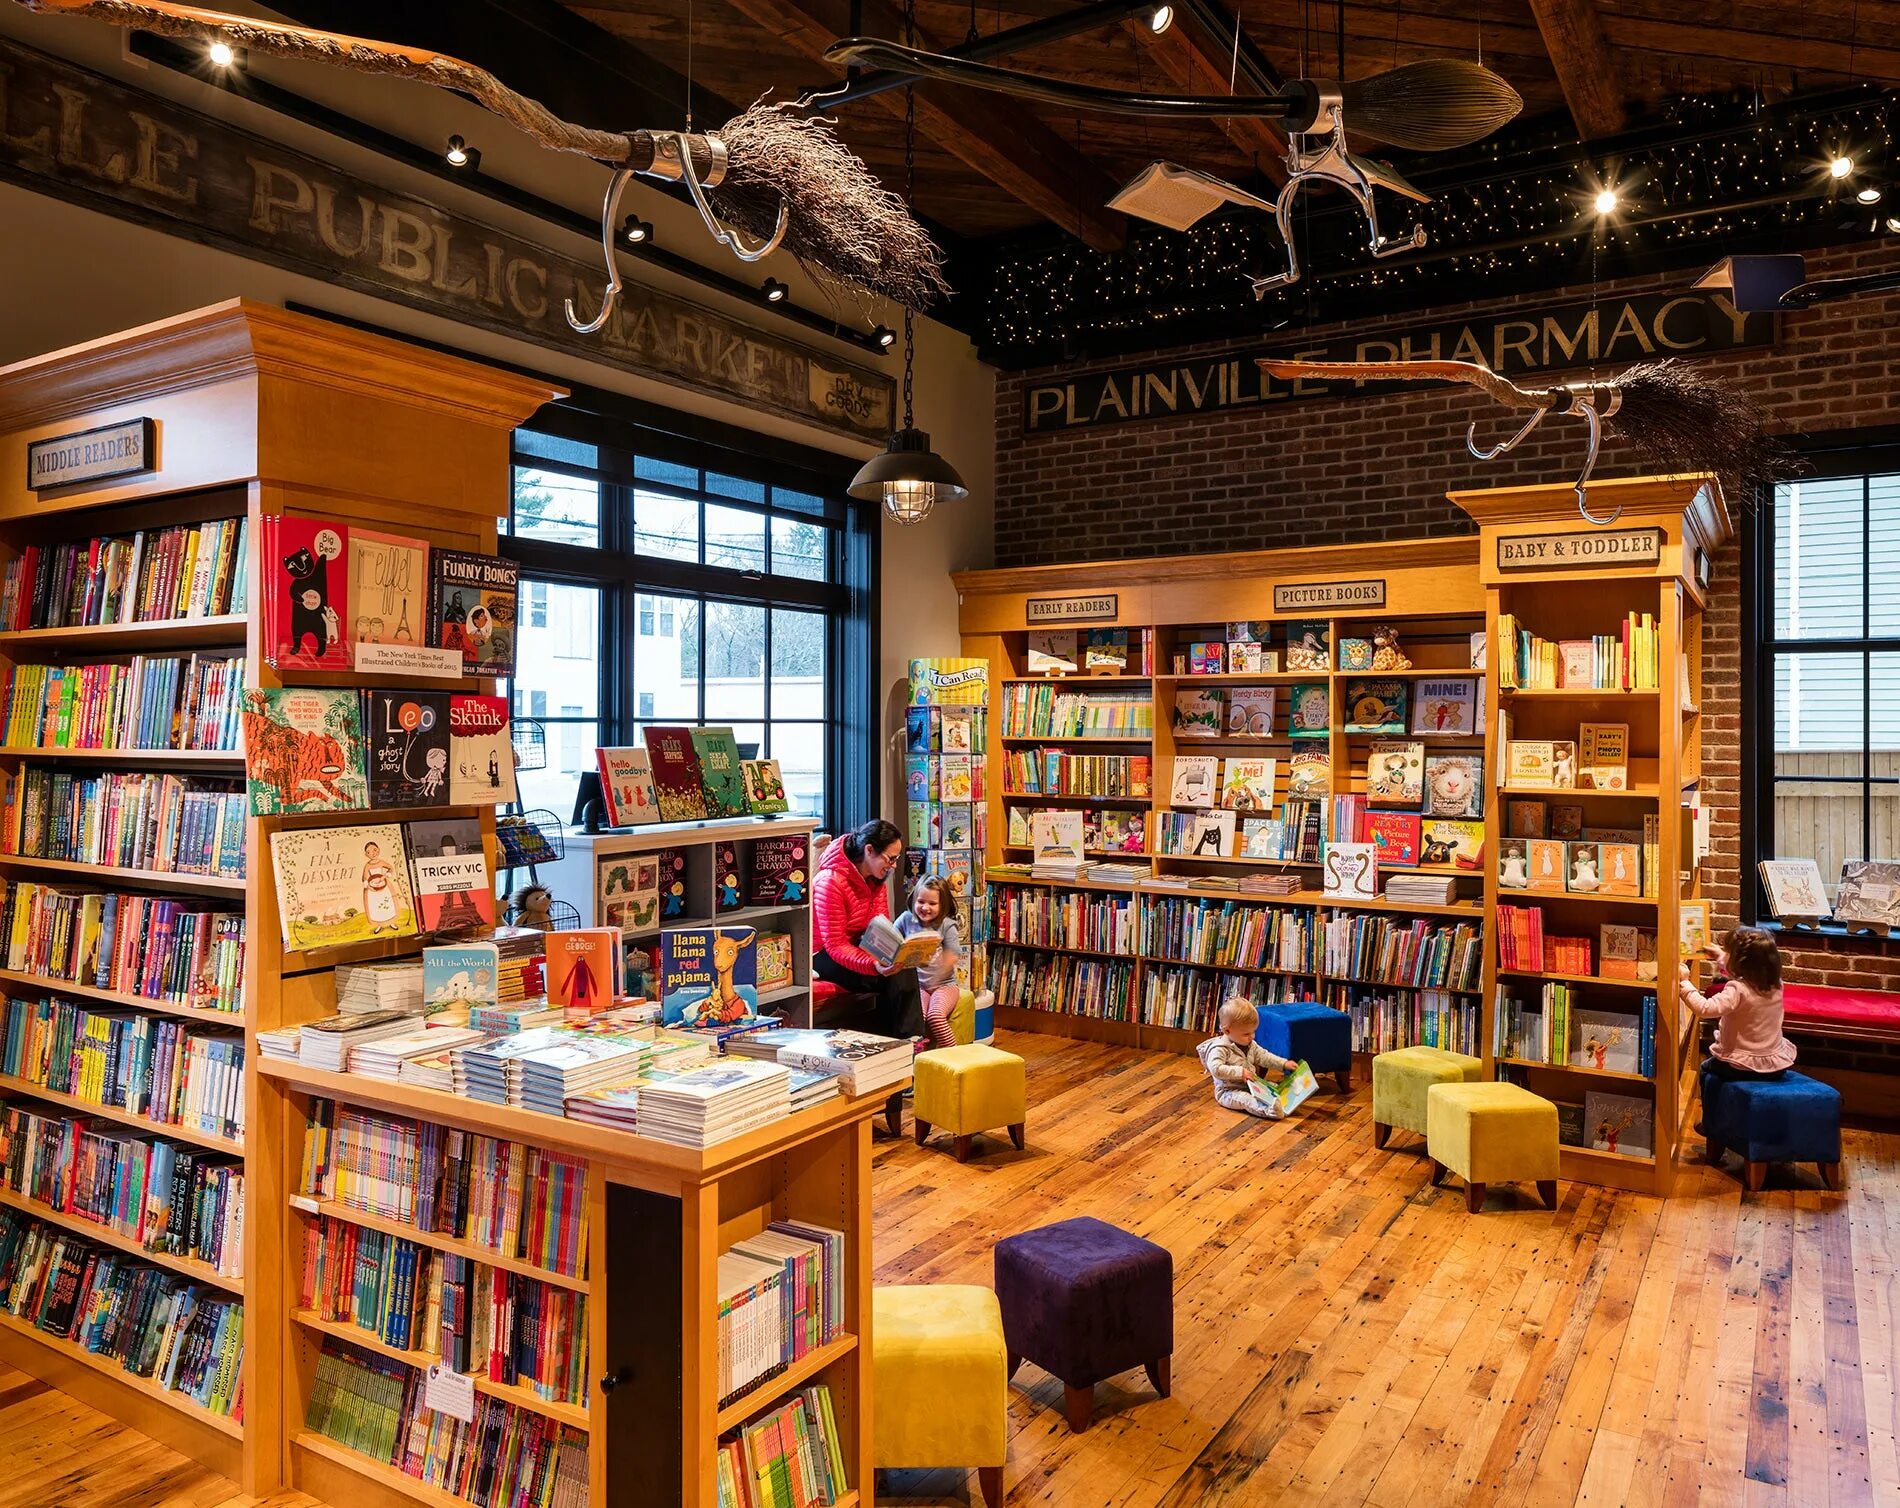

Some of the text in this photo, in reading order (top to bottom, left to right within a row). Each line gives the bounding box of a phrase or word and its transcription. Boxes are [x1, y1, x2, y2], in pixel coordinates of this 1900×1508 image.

[245, 154, 549, 319] PUBLIC
[1030, 293, 1751, 429] PLAINVILLE PHARMACY
[835, 376, 864, 397] DRY
[825, 390, 871, 419] GOODS
[37, 434, 140, 474] MIDDLE READERS
[321, 533, 335, 546] Big
[318, 542, 337, 554] Bear
[1505, 536, 1653, 559] BABY & TODDLER
[442, 560, 517, 585] FUNNY BONES
[1282, 585, 1378, 602] PICTURE BOOKS
[1033, 600, 1111, 615] EARLY READERS
[361, 658, 398, 667] Illustrated
[398, 659, 421, 668] Children's
[444, 663, 458, 671] 2015
[940, 675, 961, 685] Can
[962, 669, 985, 681] Read!
[1233, 689, 1273, 698] Nerdy Birdy
[1424, 683, 1467, 696] MINE!
[464, 700, 488, 713] The
[383, 698, 436, 734] Leo
[450, 707, 503, 727] Skunk
[388, 737, 396, 745] a
[378, 746, 403, 765] ghost
[379, 761, 401, 773] story
[610, 759, 631, 769] hello
[615, 767, 648, 778] goodbye
[1242, 766, 1264, 778] ME!
[1244, 819, 1274, 827] SPACE
[1384, 829, 1410, 838] Picture
[324, 841, 331, 852] A
[756, 841, 793, 850] HAROLD
[1390, 839, 1409, 848] Book
[310, 853, 345, 867] FINE
[756, 854, 792, 863] PURPLE
[947, 859, 969, 870] Dixie
[421, 863, 483, 879] TRICKY VIC
[756, 861, 793, 870] CRAYON
[301, 866, 357, 885] DESSERT
[673, 934, 706, 945] llama
[1616, 932, 1634, 941] TIME
[565, 942, 596, 951] GEORGE!
[673, 946, 706, 958] llama
[427, 956, 494, 968] All the World
[679, 958, 700, 969] red
[667, 971, 711, 987] pajama
[812, 1055, 831, 1069] Otis
[175, 1178, 187, 1231] BOUNDERS
